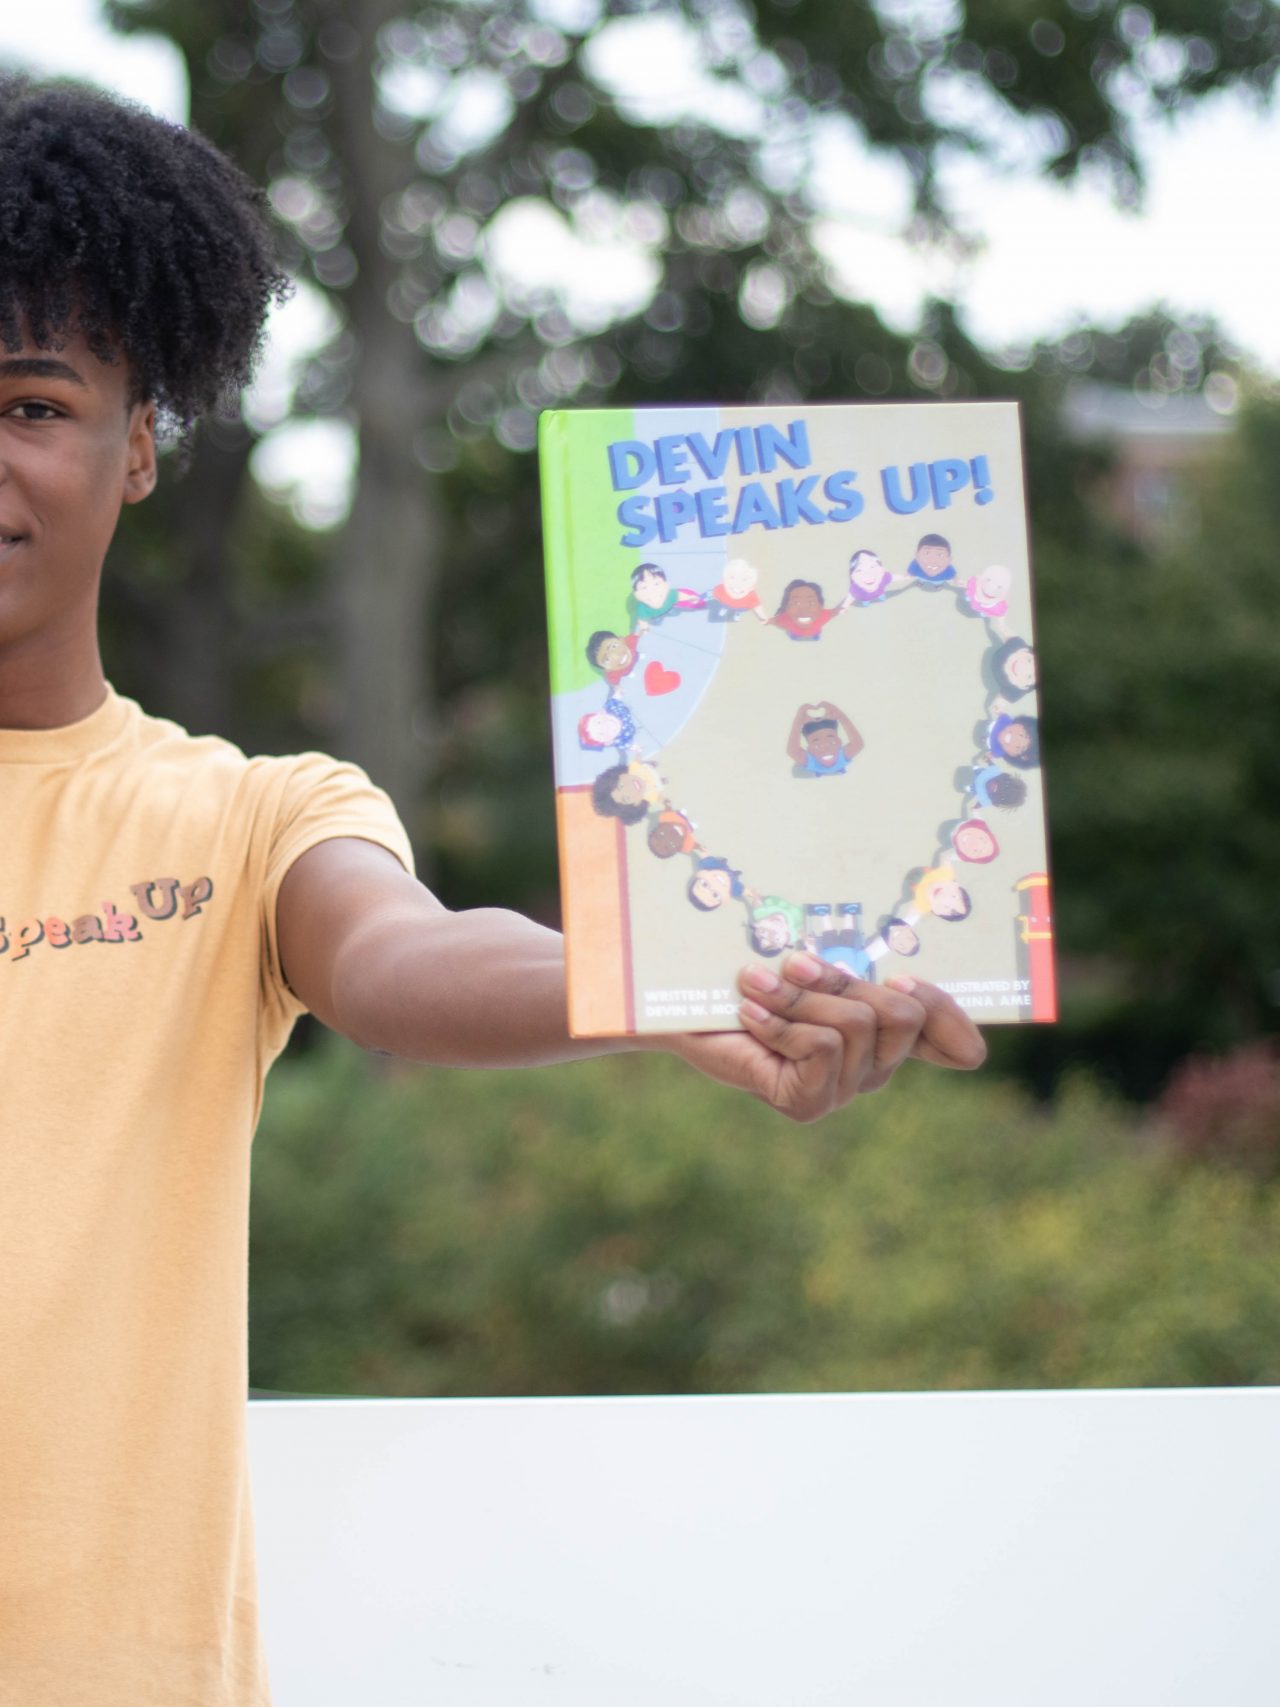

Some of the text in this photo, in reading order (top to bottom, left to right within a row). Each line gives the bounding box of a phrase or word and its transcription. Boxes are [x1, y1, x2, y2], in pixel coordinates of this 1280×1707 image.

[607, 419, 811, 492] DEVIN
[617, 455, 995, 548] SPEAKS UP!
[1013, 979, 1030, 991] BY
[645, 989, 730, 1001] WRITTEN BY
[1000, 995, 1031, 1006] AME
[645, 1005, 687, 1017] DEVIN
[711, 1003, 738, 1015] MO
